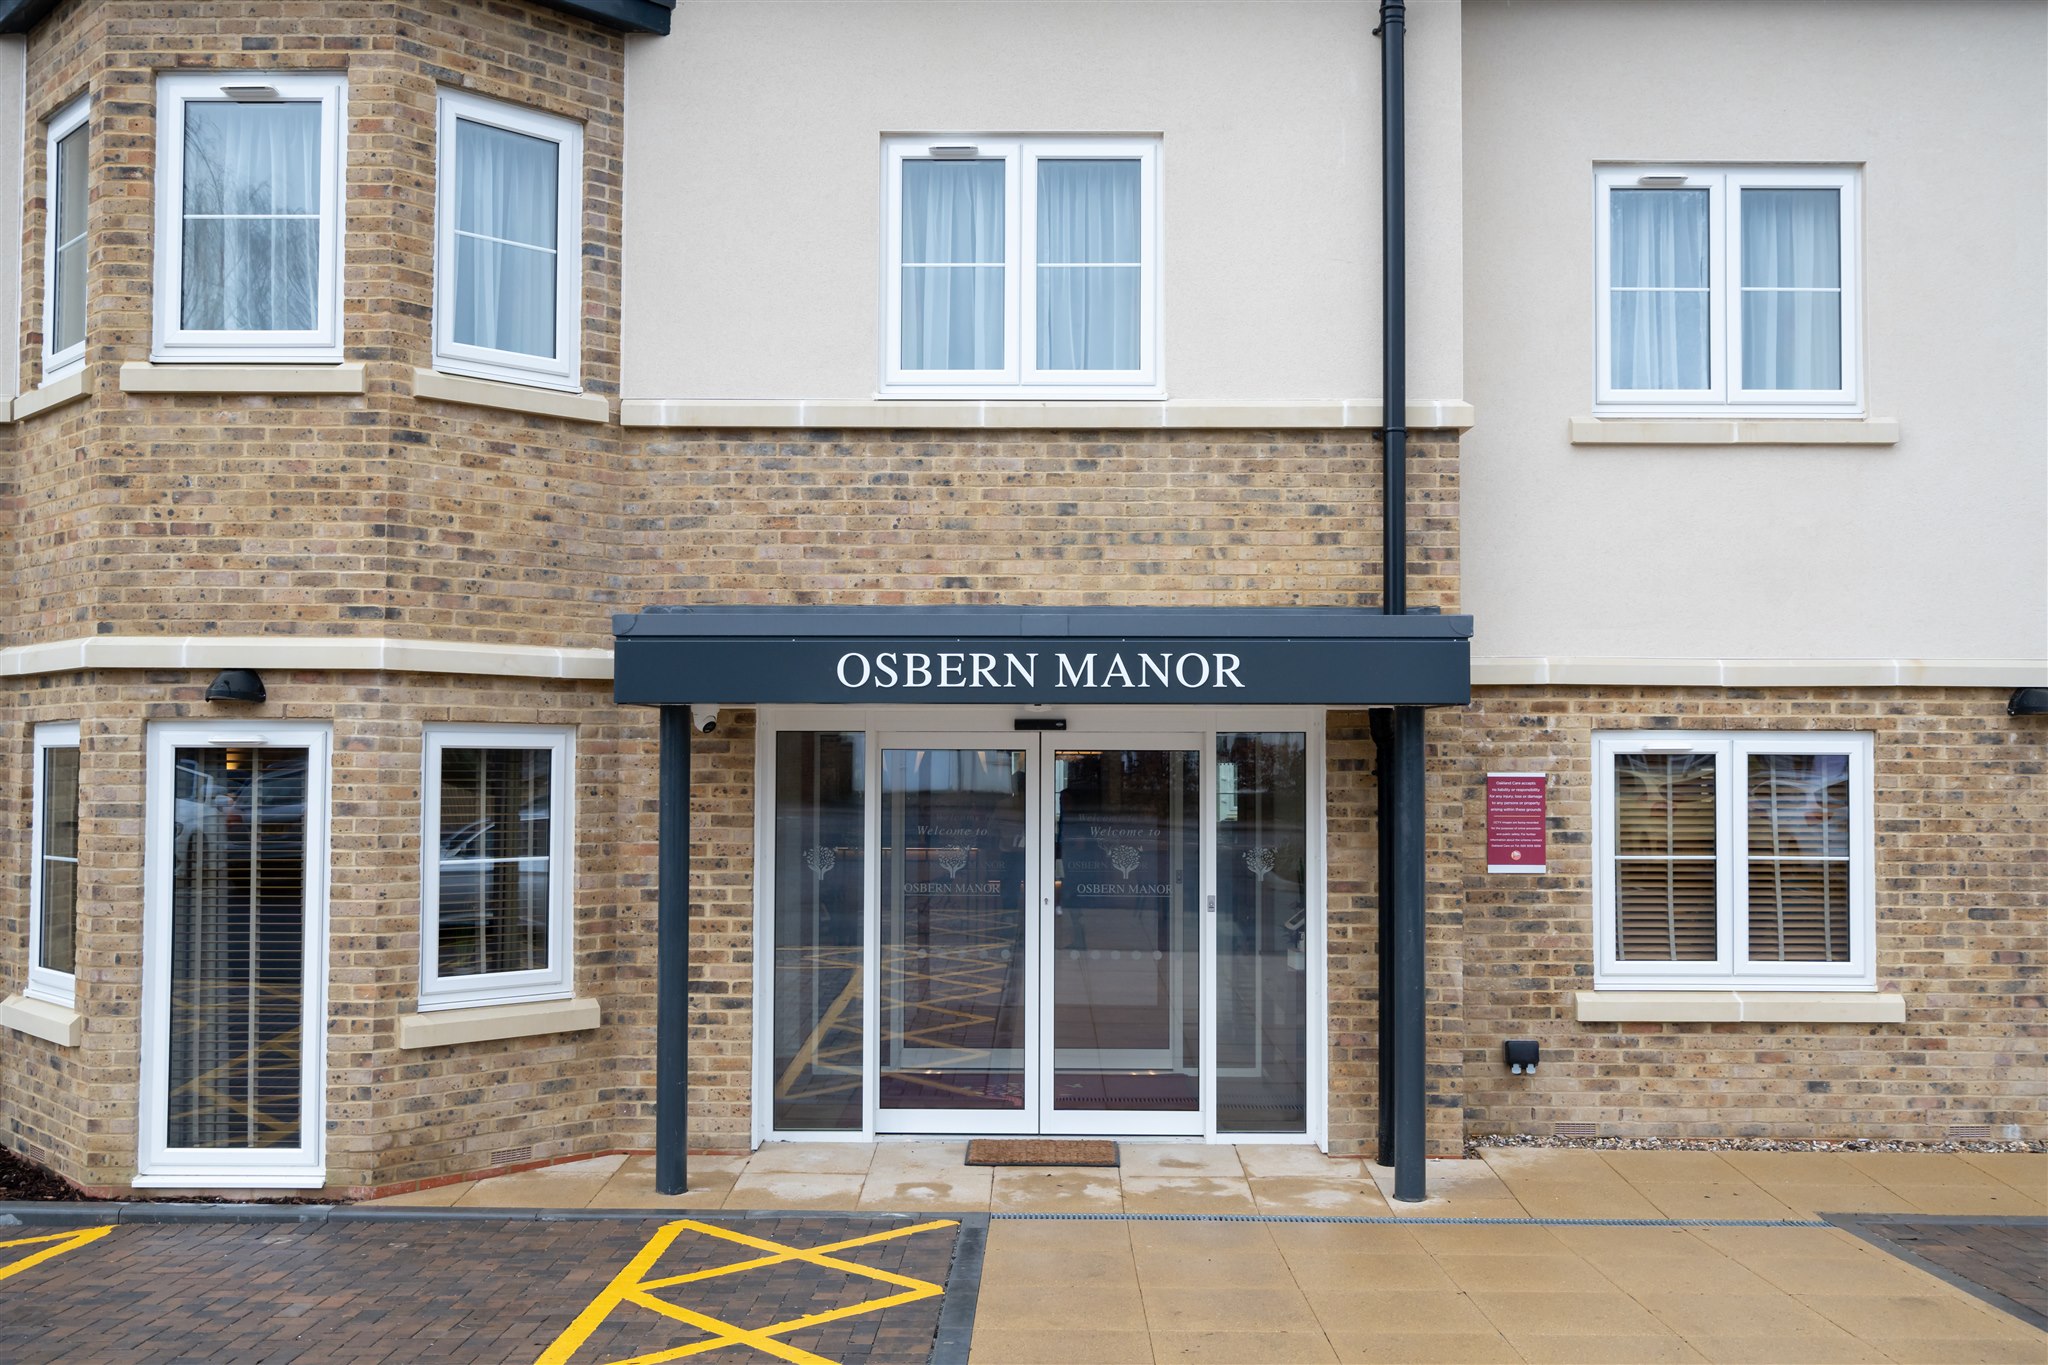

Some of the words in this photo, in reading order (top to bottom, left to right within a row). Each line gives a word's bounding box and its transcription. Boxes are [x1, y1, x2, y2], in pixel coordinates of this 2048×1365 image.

[836, 652, 1038, 688] OSBERN
[1055, 652, 1245, 688] MANOR
[918, 825, 973, 836] Welcome
[976, 825, 988, 836] to
[1090, 826, 1144, 837] Welcome
[1148, 826, 1161, 837] to
[904, 883, 952, 894] OSBERN
[955, 883, 1000, 894] MANOR
[1076, 884, 1125, 894] OSBERN
[1128, 884, 1172, 894] MANOR
